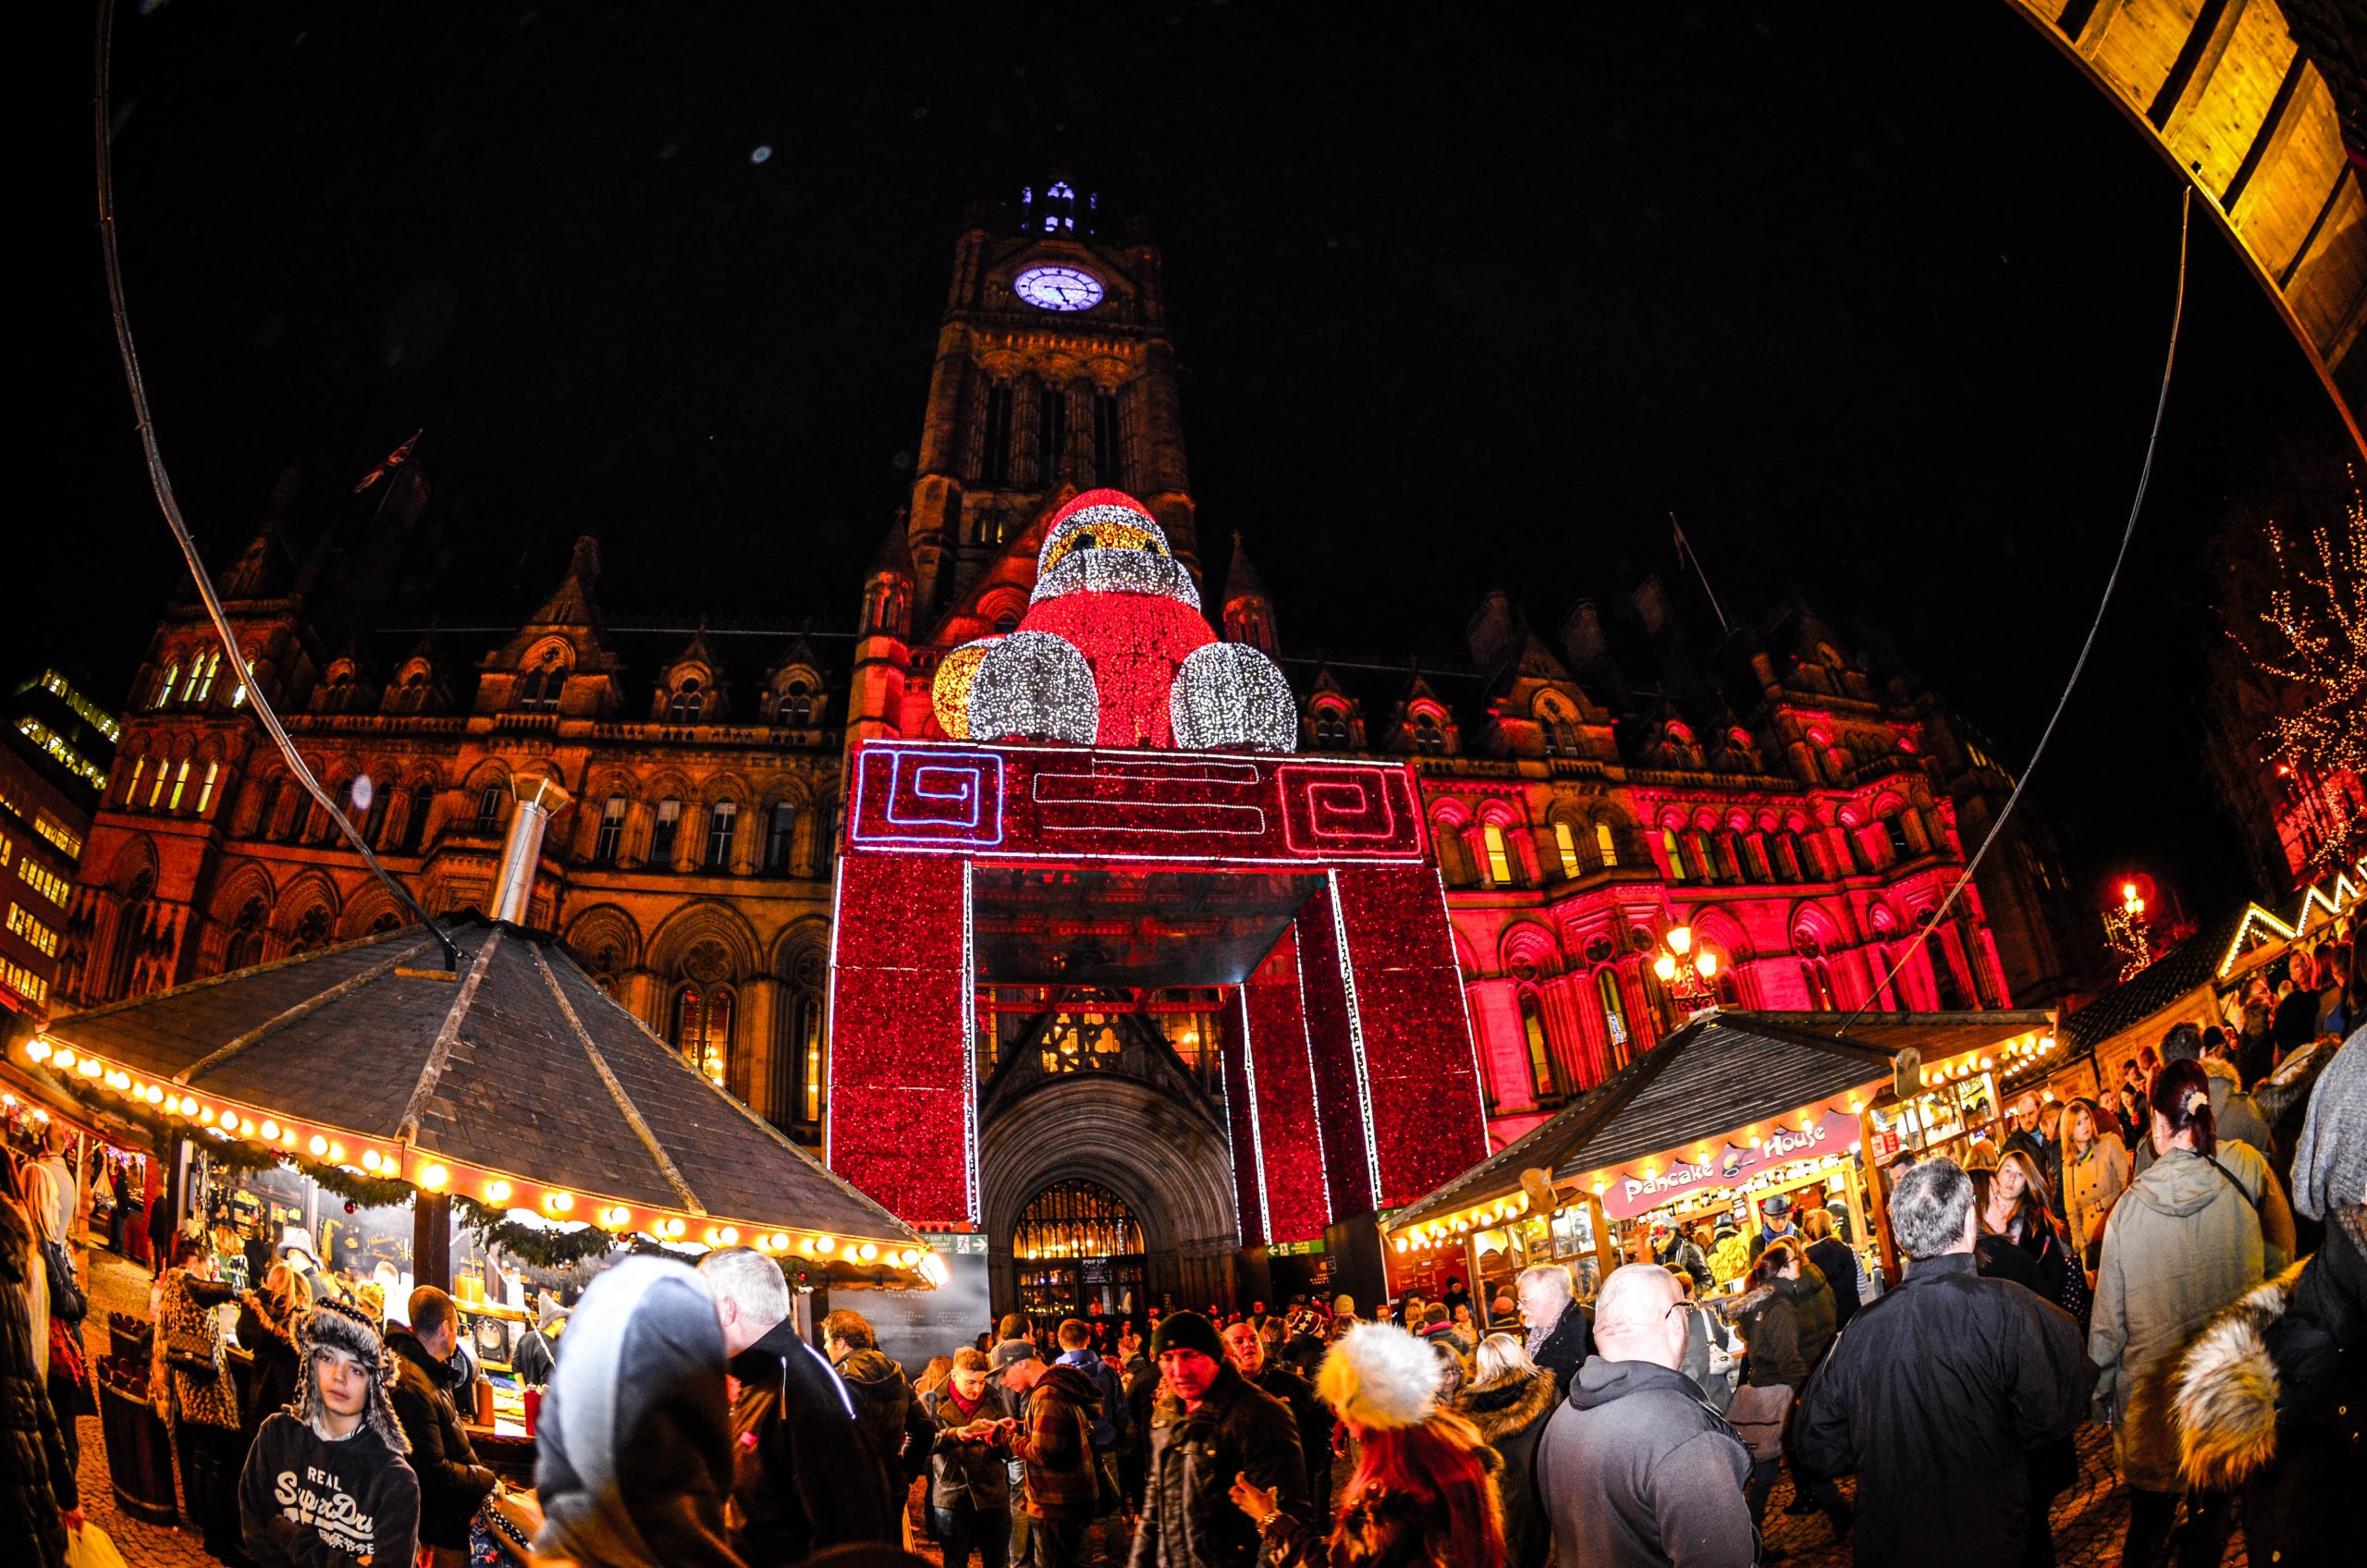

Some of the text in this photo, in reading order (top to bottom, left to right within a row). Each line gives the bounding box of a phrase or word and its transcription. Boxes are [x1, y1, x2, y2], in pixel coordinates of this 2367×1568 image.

[1625, 1127, 1826, 1205] Pancake House
[308, 1465, 342, 1492] REAL
